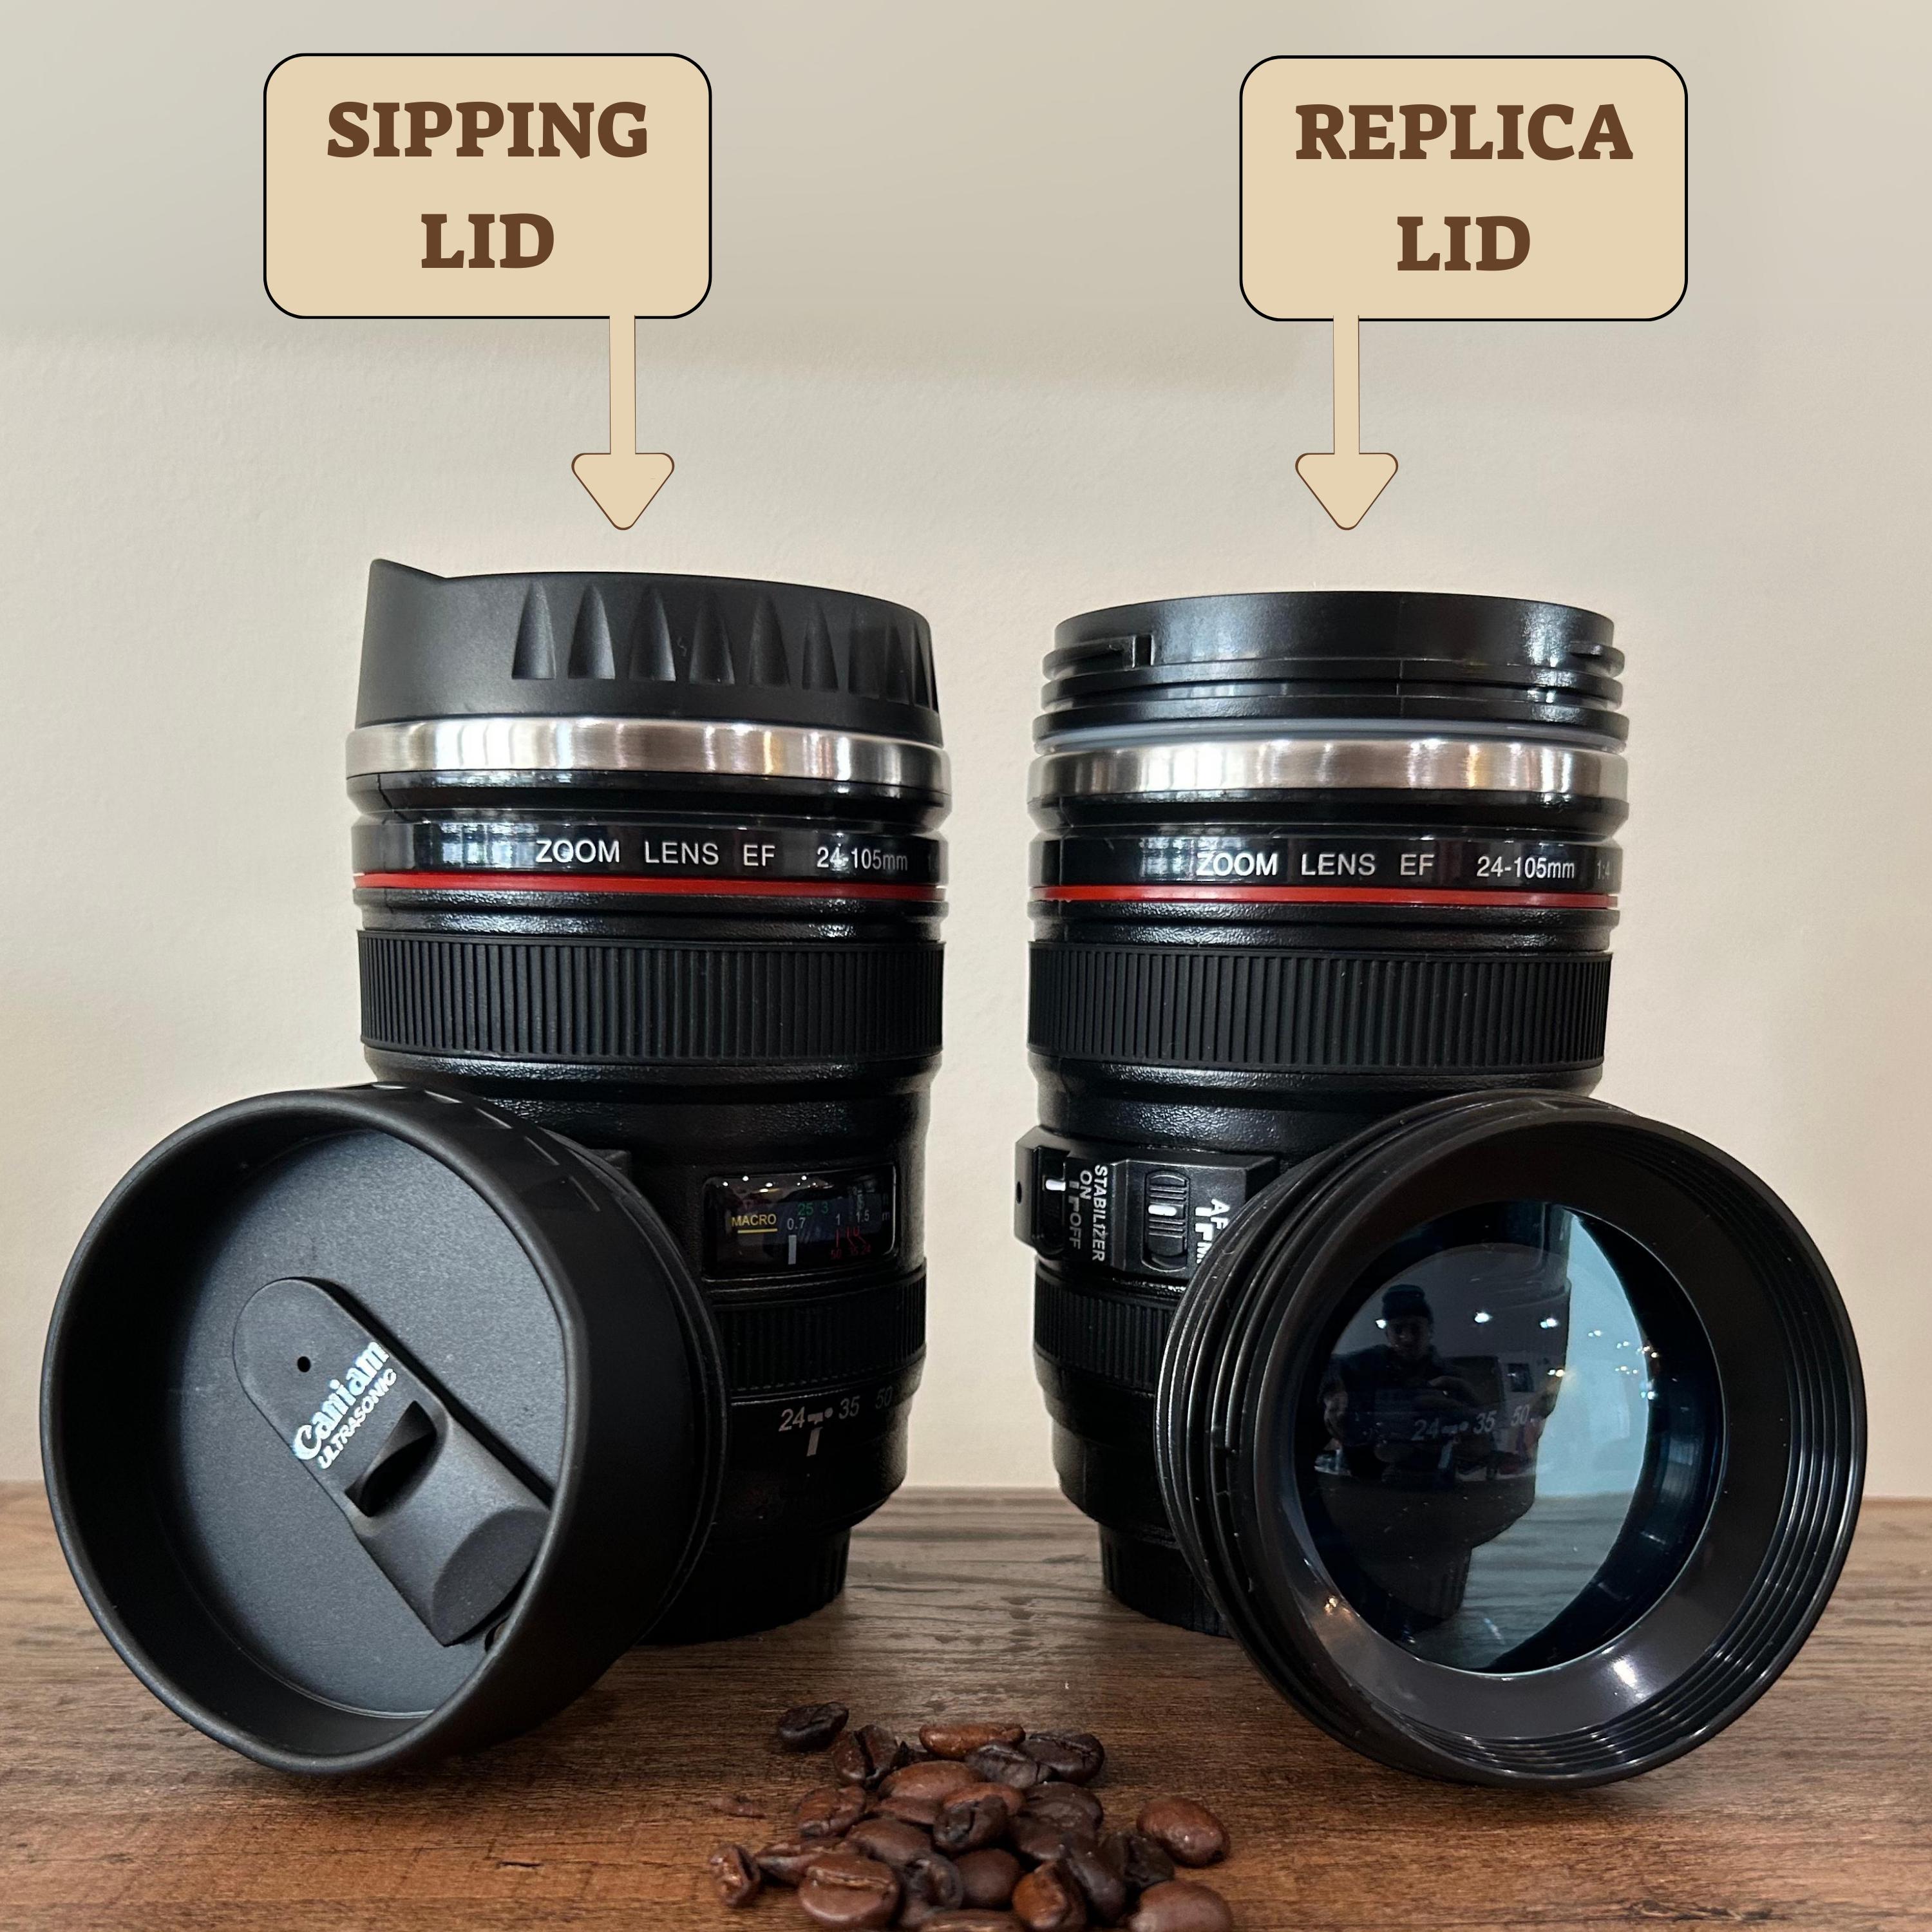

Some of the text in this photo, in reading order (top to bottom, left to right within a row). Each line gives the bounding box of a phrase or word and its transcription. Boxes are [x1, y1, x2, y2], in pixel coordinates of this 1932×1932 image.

[535, 840, 620, 864] ZOOM
[645, 842, 719, 866] LENS
[743, 845, 775, 867] EF
[1195, 853, 1278, 876] ZOOM
[1301, 853, 1376, 876] LENS
[1399, 854, 1435, 876] EF
[1477, 855, 1575, 880] 24-105mm
[1080, 1170, 1093, 1200] ON
[731, 1213, 777, 1227] MACRO
[786, 1217, 806, 1231] 0.7
[855, 1211, 870, 1223] 1.5
[1092, 1164, 1109, 1262] STABILIZER
[1210, 1198, 1231, 1231] AF
[1069, 1211, 1083, 1250] OFF
[293, 1341, 390, 1460] Caniam
[778, 1386, 893, 1432] 24 35 50
[317, 1368, 397, 1470] ULTRASONIC
[1412, 1405, 1530, 1441] 24 35 50
